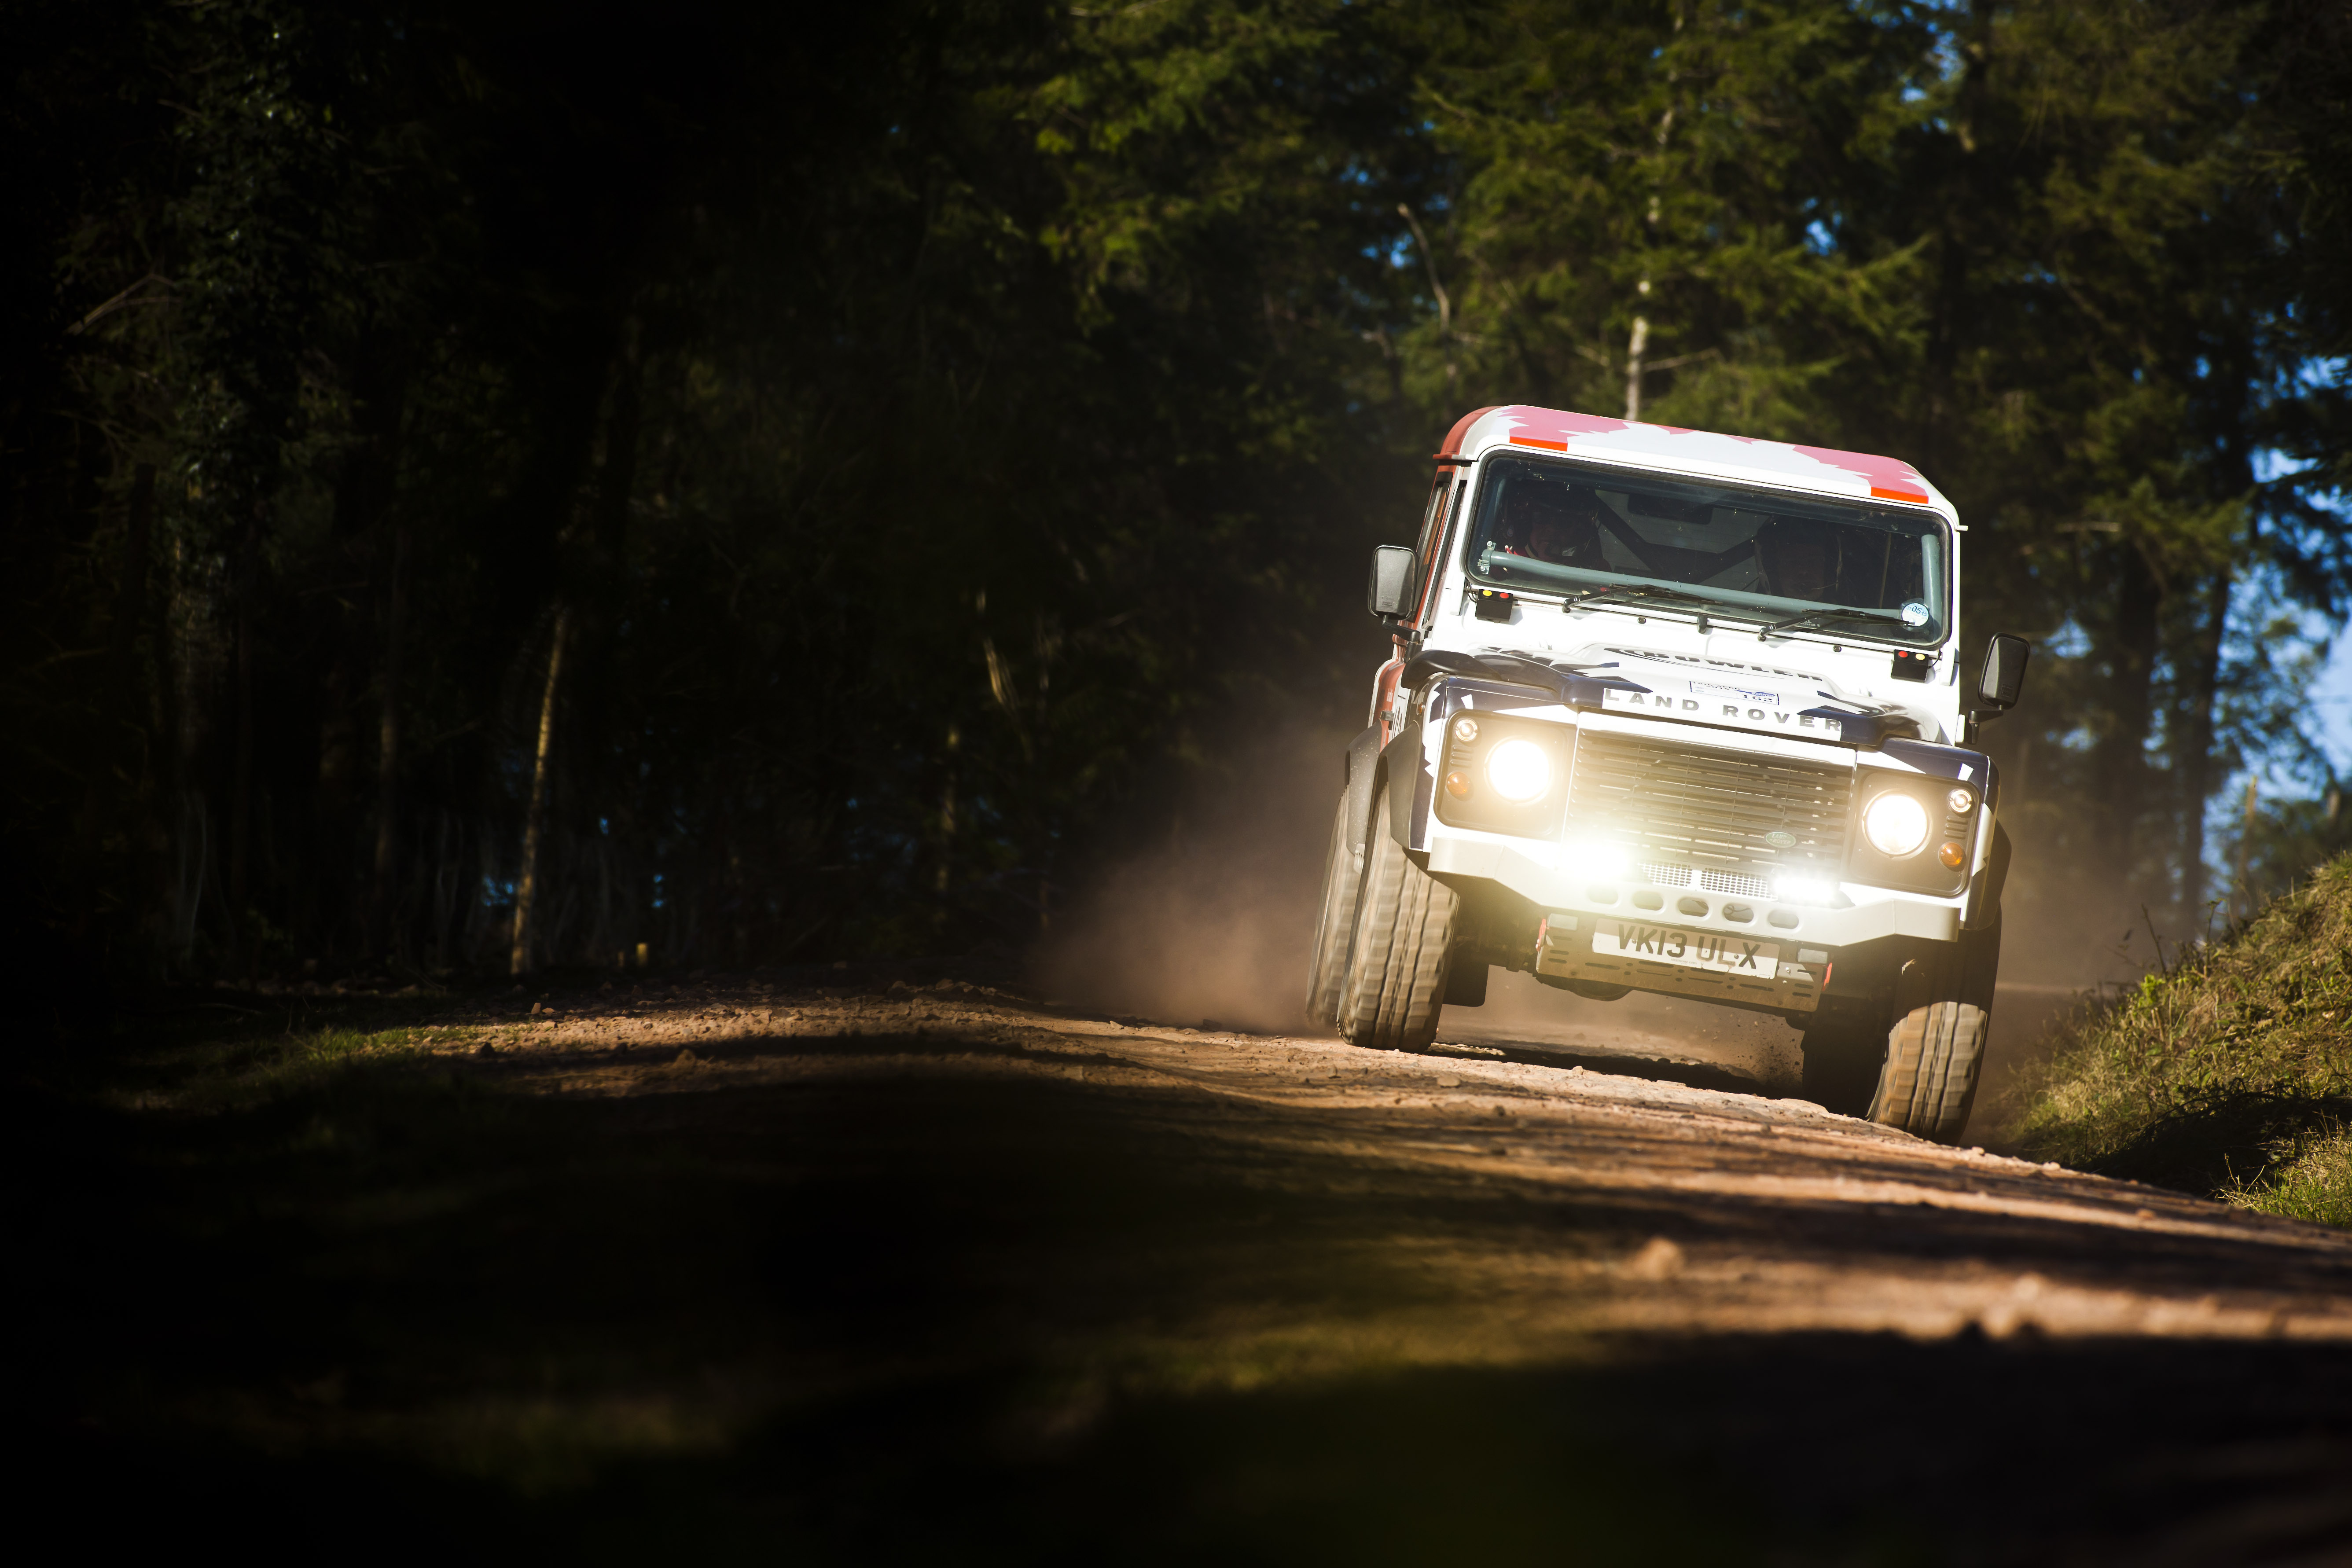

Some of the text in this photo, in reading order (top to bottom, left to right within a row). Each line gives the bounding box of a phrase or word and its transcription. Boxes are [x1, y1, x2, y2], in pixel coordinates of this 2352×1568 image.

[1604, 689, 1841, 731] LAND ROVER
[1742, 694, 1773, 703] 162
[1618, 924, 1760, 969] VK13 ULX
